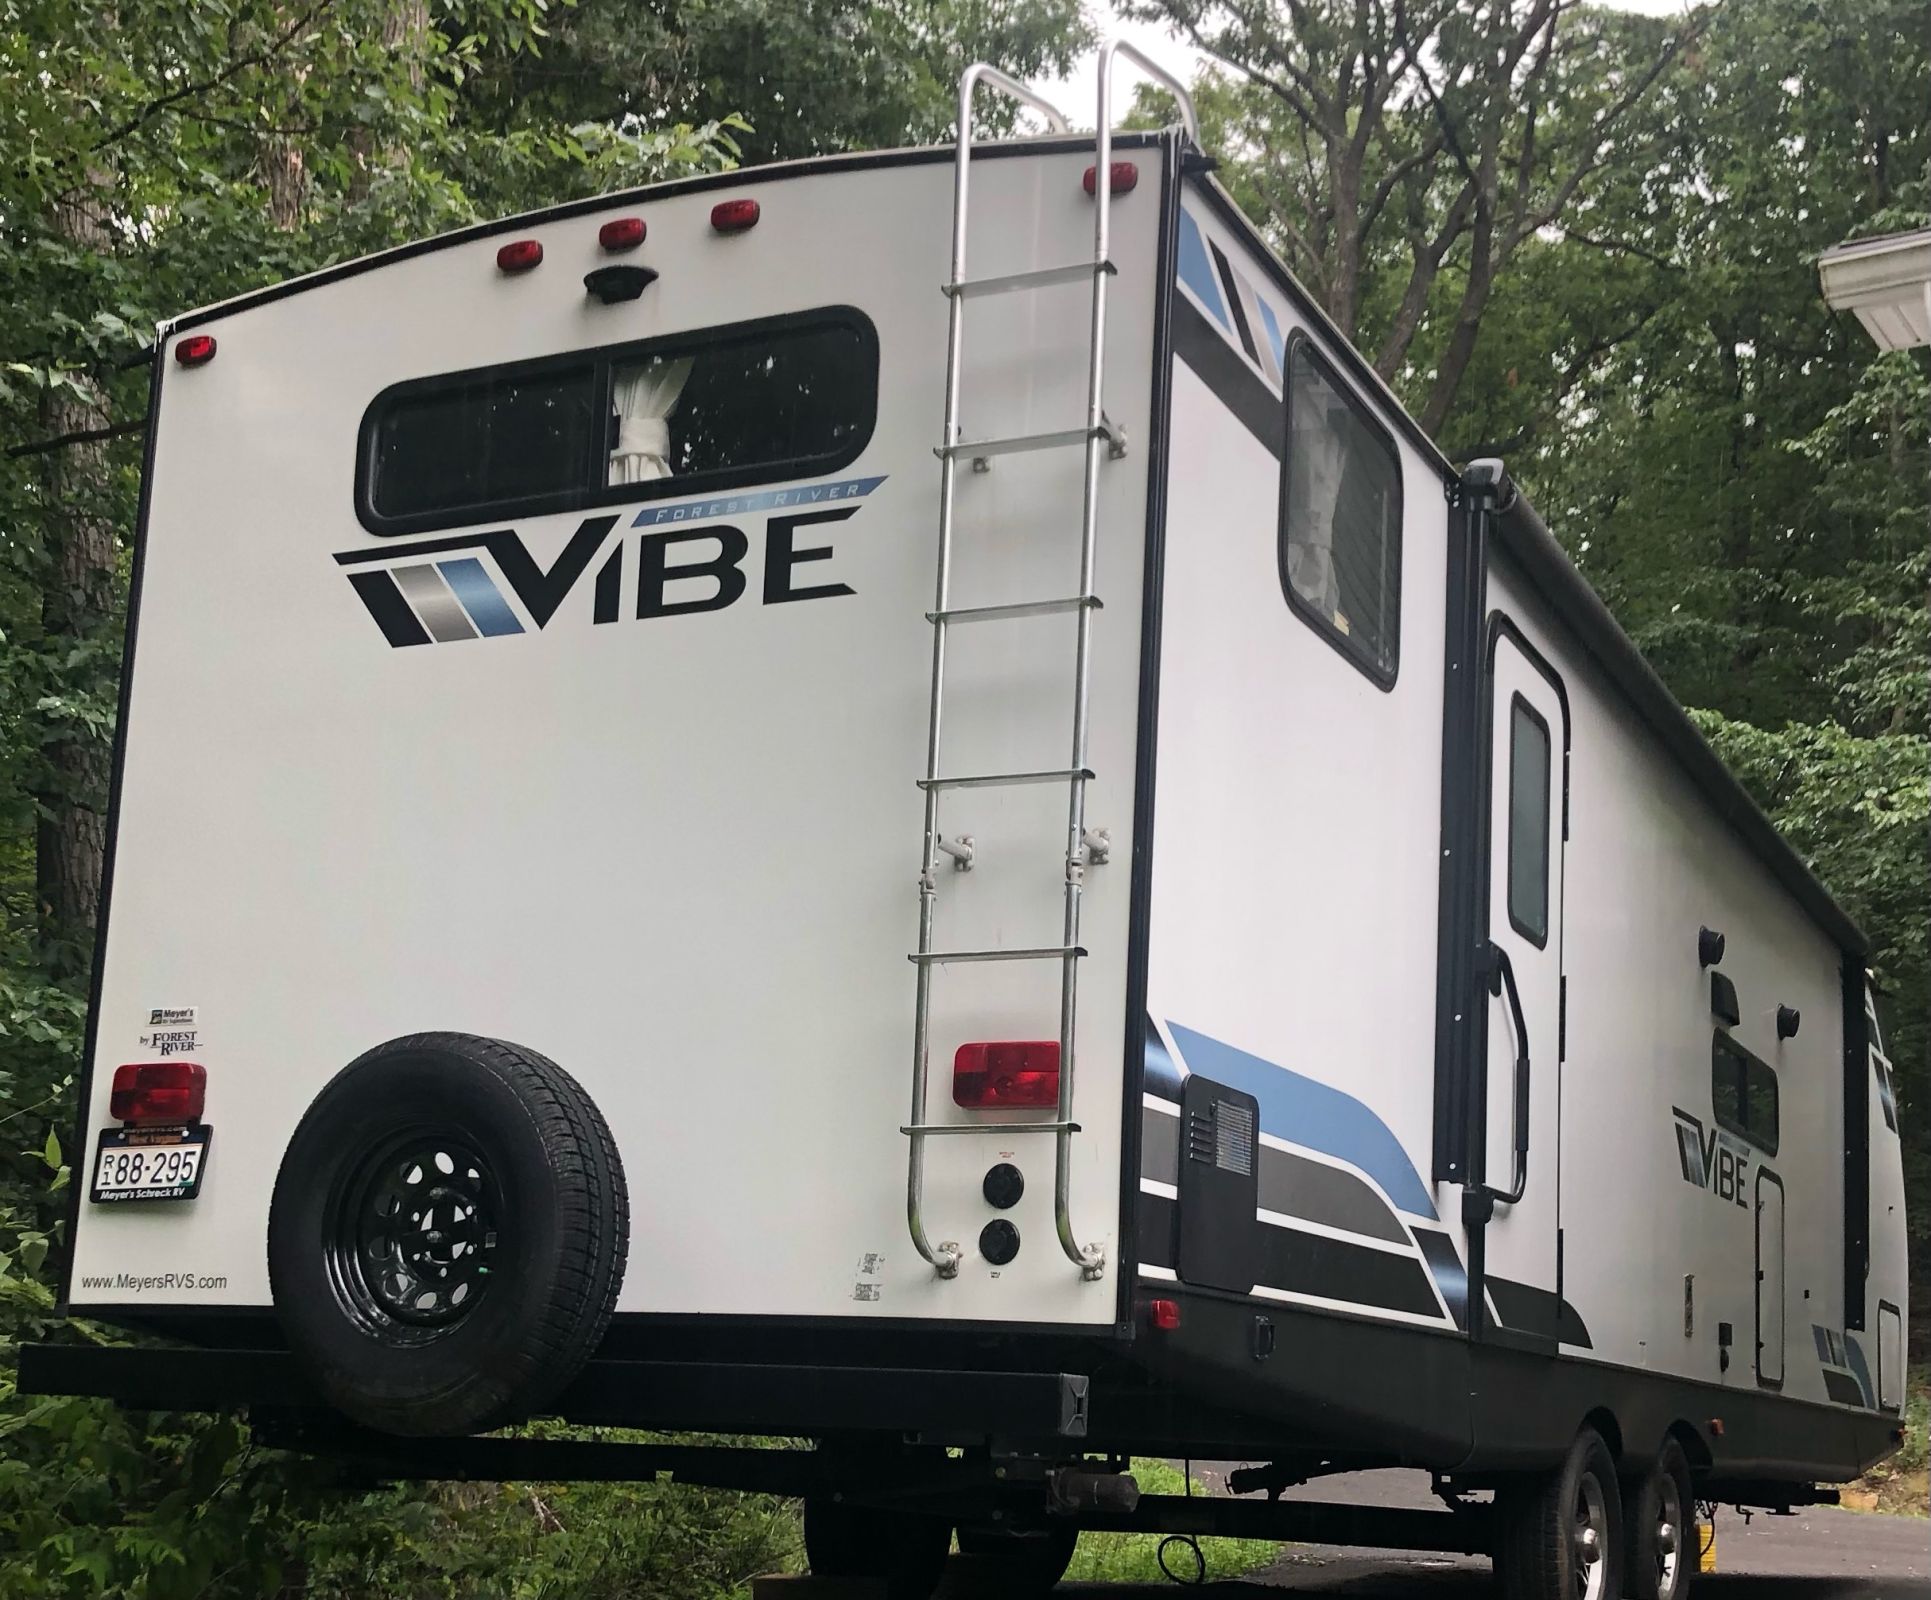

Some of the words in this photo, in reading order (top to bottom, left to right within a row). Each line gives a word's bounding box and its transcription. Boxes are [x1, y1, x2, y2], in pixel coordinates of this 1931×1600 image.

[655, 499, 753, 523] FOREST
[774, 484, 859, 505] RIVER
[331, 505, 863, 633] VIBE
[139, 1036, 149, 1046] by
[152, 1031, 198, 1047] FOREST
[160, 1041, 195, 1056] RIVER
[1672, 1105, 1748, 1209] VIBE
[100, 1190, 135, 1201] Meyer's
[173, 1187, 185, 1197] RV
[82, 1273, 228, 1293] www.MeyersRVS.com
